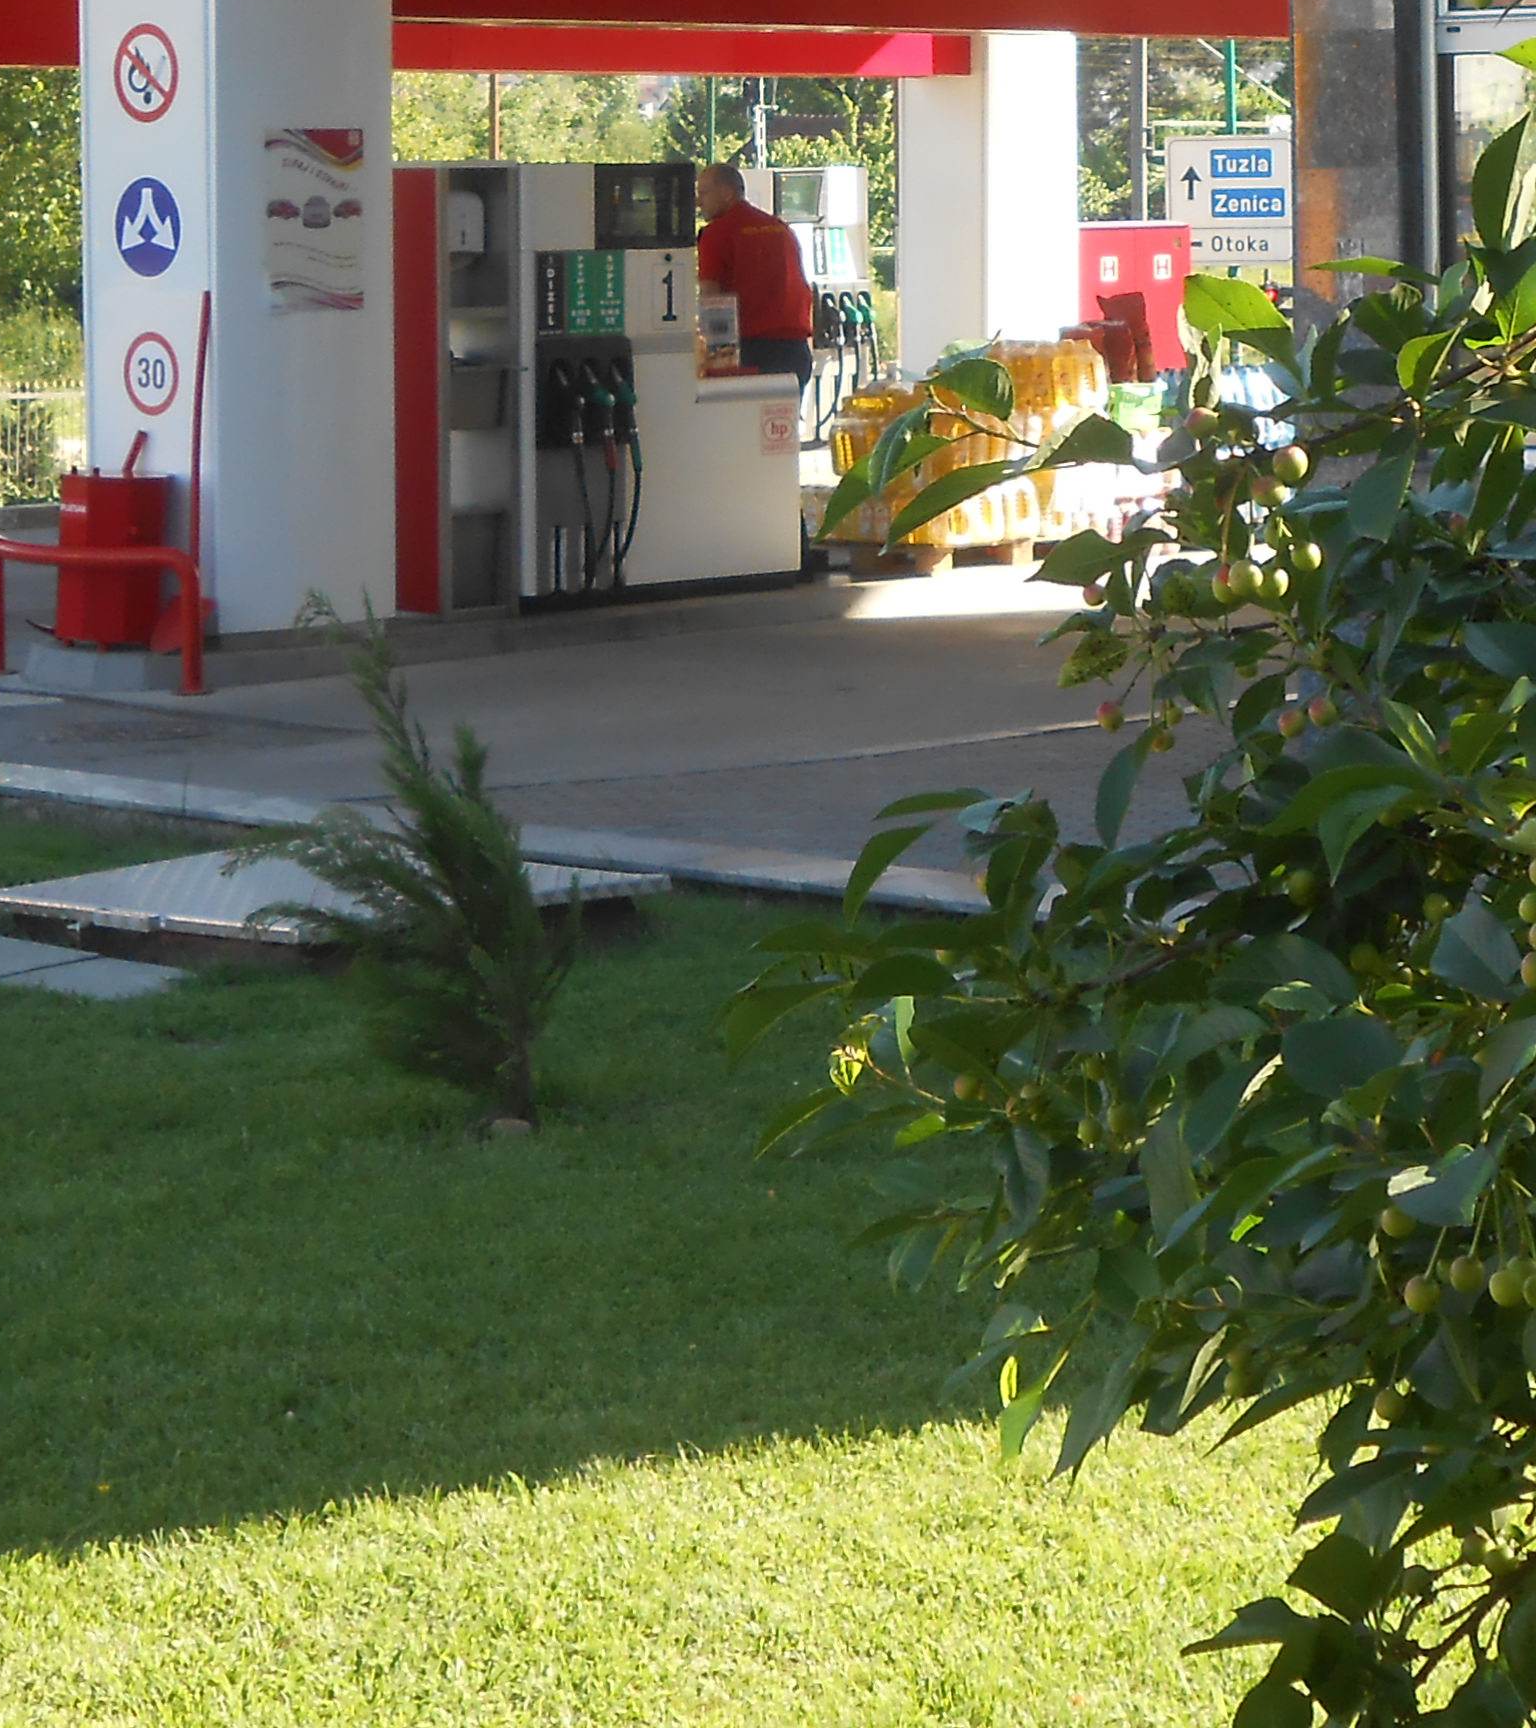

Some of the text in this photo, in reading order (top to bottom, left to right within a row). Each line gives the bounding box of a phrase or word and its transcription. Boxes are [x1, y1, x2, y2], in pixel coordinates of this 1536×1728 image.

[1213, 154, 1269, 173] Tuzla
[1214, 194, 1282, 213] Zenica
[1211, 235, 1269, 252] Otoka
[546, 268, 556, 326] DIZEL
[662, 270, 677, 322] 1
[137, 357, 165, 389] 30
